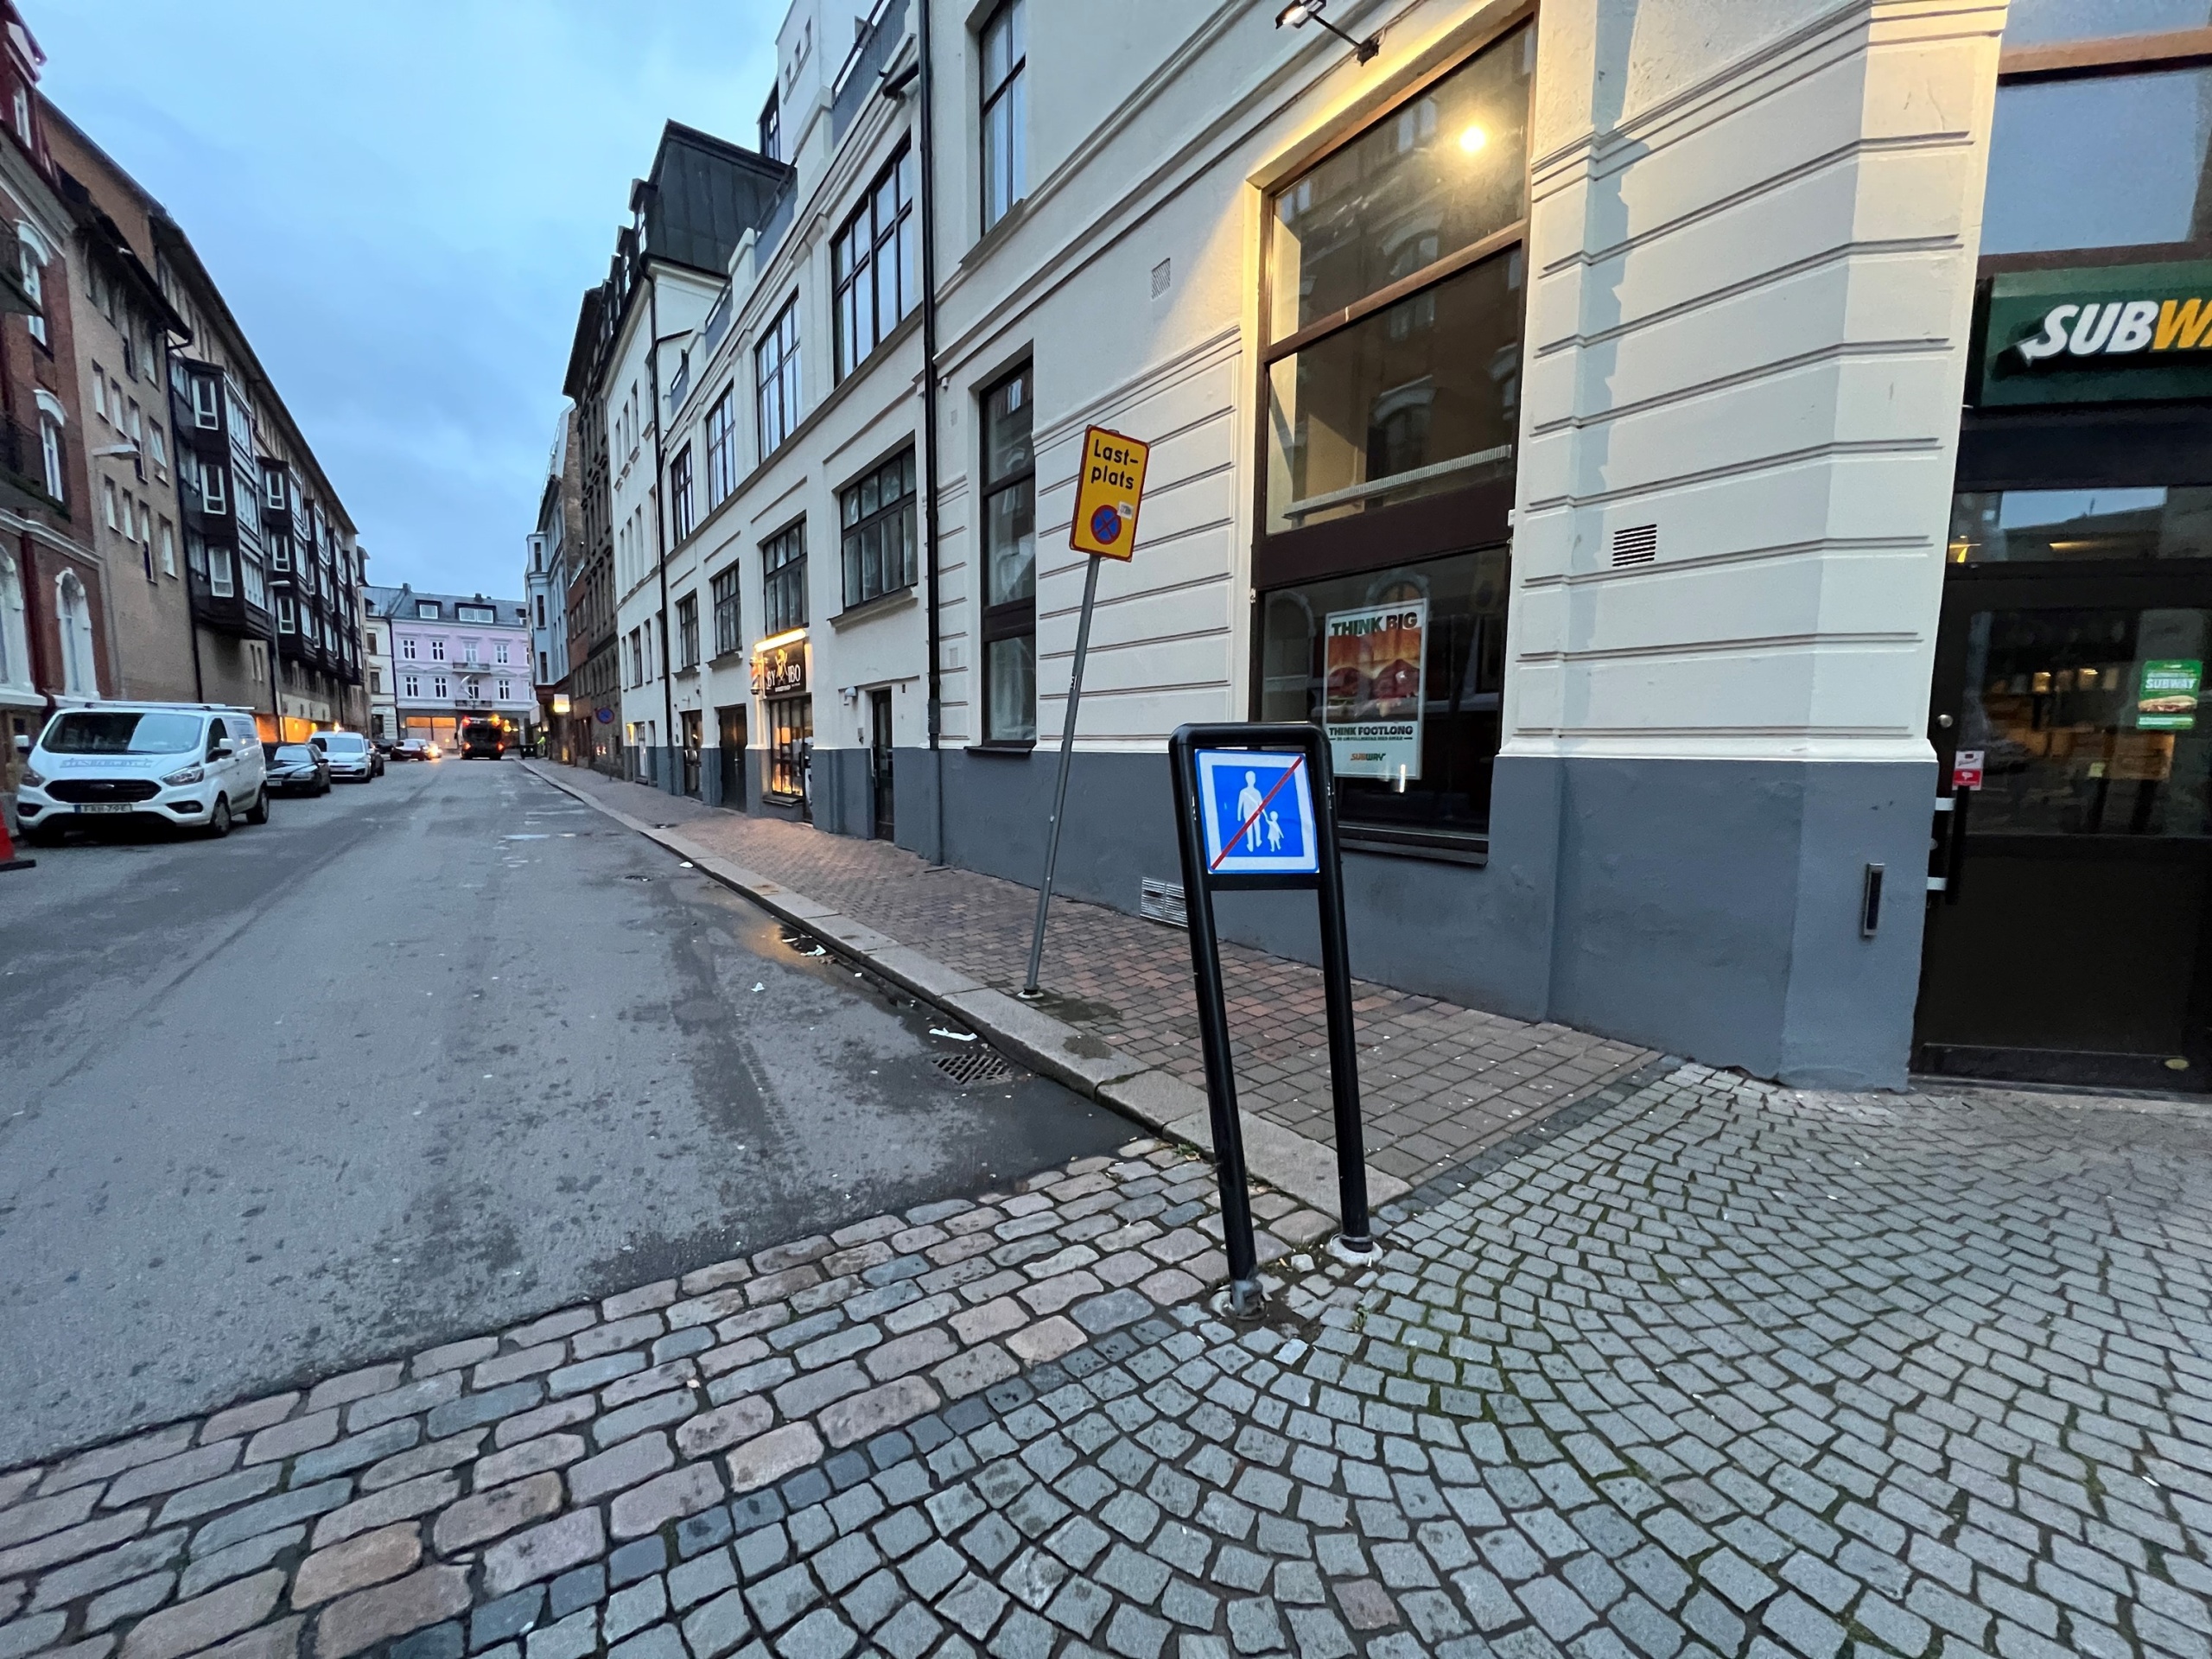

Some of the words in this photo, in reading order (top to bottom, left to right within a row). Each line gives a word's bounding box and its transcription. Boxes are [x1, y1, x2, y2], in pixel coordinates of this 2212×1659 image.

[1094, 439, 1139, 466] Last-
[1090, 465, 1135, 490] plats
[1332, 616, 1382, 636] THINK
[1386, 612, 1418, 631] BIG
[766, 670, 776, 688] BY
[1329, 727, 1357, 736] THINK
[1357, 725, 1414, 736] FOOTLONG
[1350, 753, 1387, 761] SUBWAY
